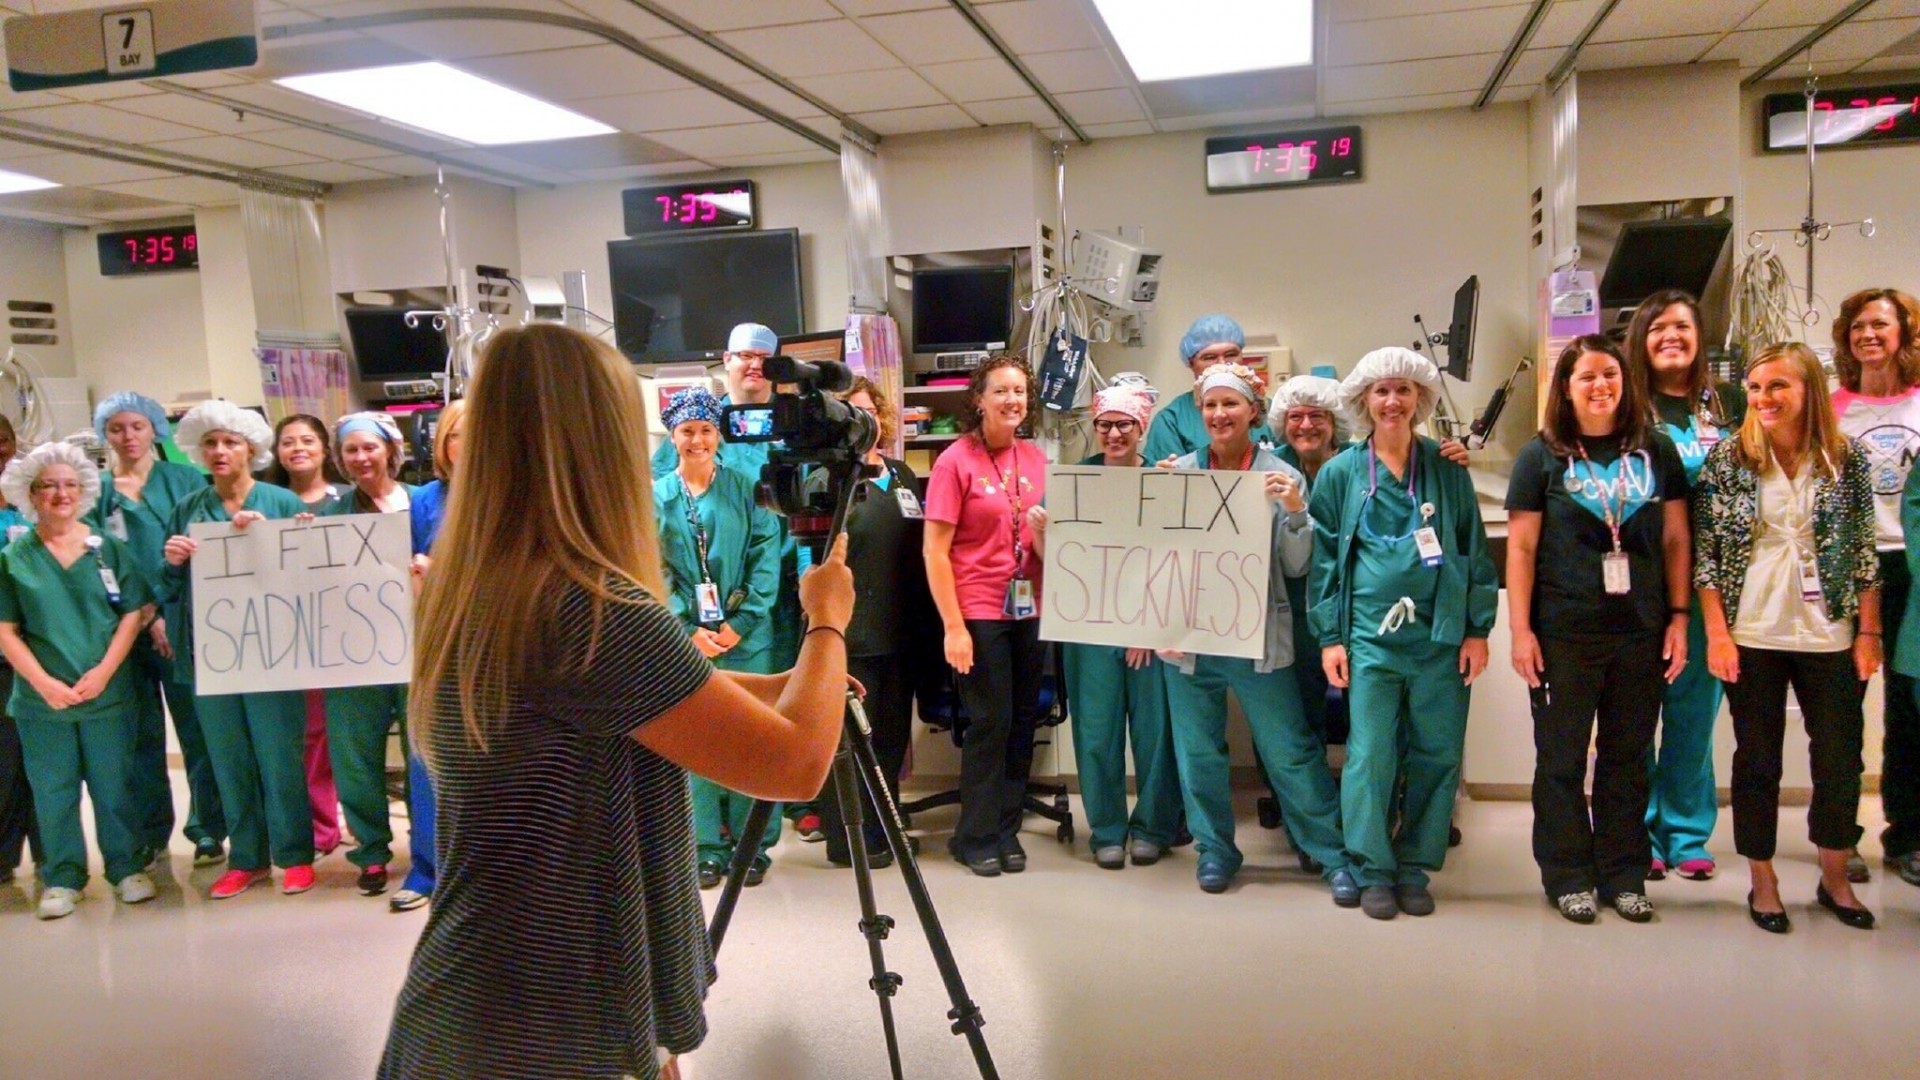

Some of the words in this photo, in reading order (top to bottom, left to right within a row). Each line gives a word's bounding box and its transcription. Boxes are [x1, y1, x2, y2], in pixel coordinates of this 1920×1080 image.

[118, 17, 135, 49] 7
[119, 53, 141, 66] BAY
[1814, 98, 1896, 131] 7:35
[1246, 139, 1318, 173] 7:35
[1331, 137, 1350, 156] 19
[656, 192, 718, 223] 7:35
[124, 236, 174, 264] 7:35
[182, 233, 196, 250] 19
[1052, 472, 1103, 525] I
[1137, 471, 1243, 535] FIX
[203, 533, 255, 581] I
[279, 520, 383, 571] FIX
[1052, 540, 1263, 642] SICKNESS
[202, 579, 408, 673] SADNESS
